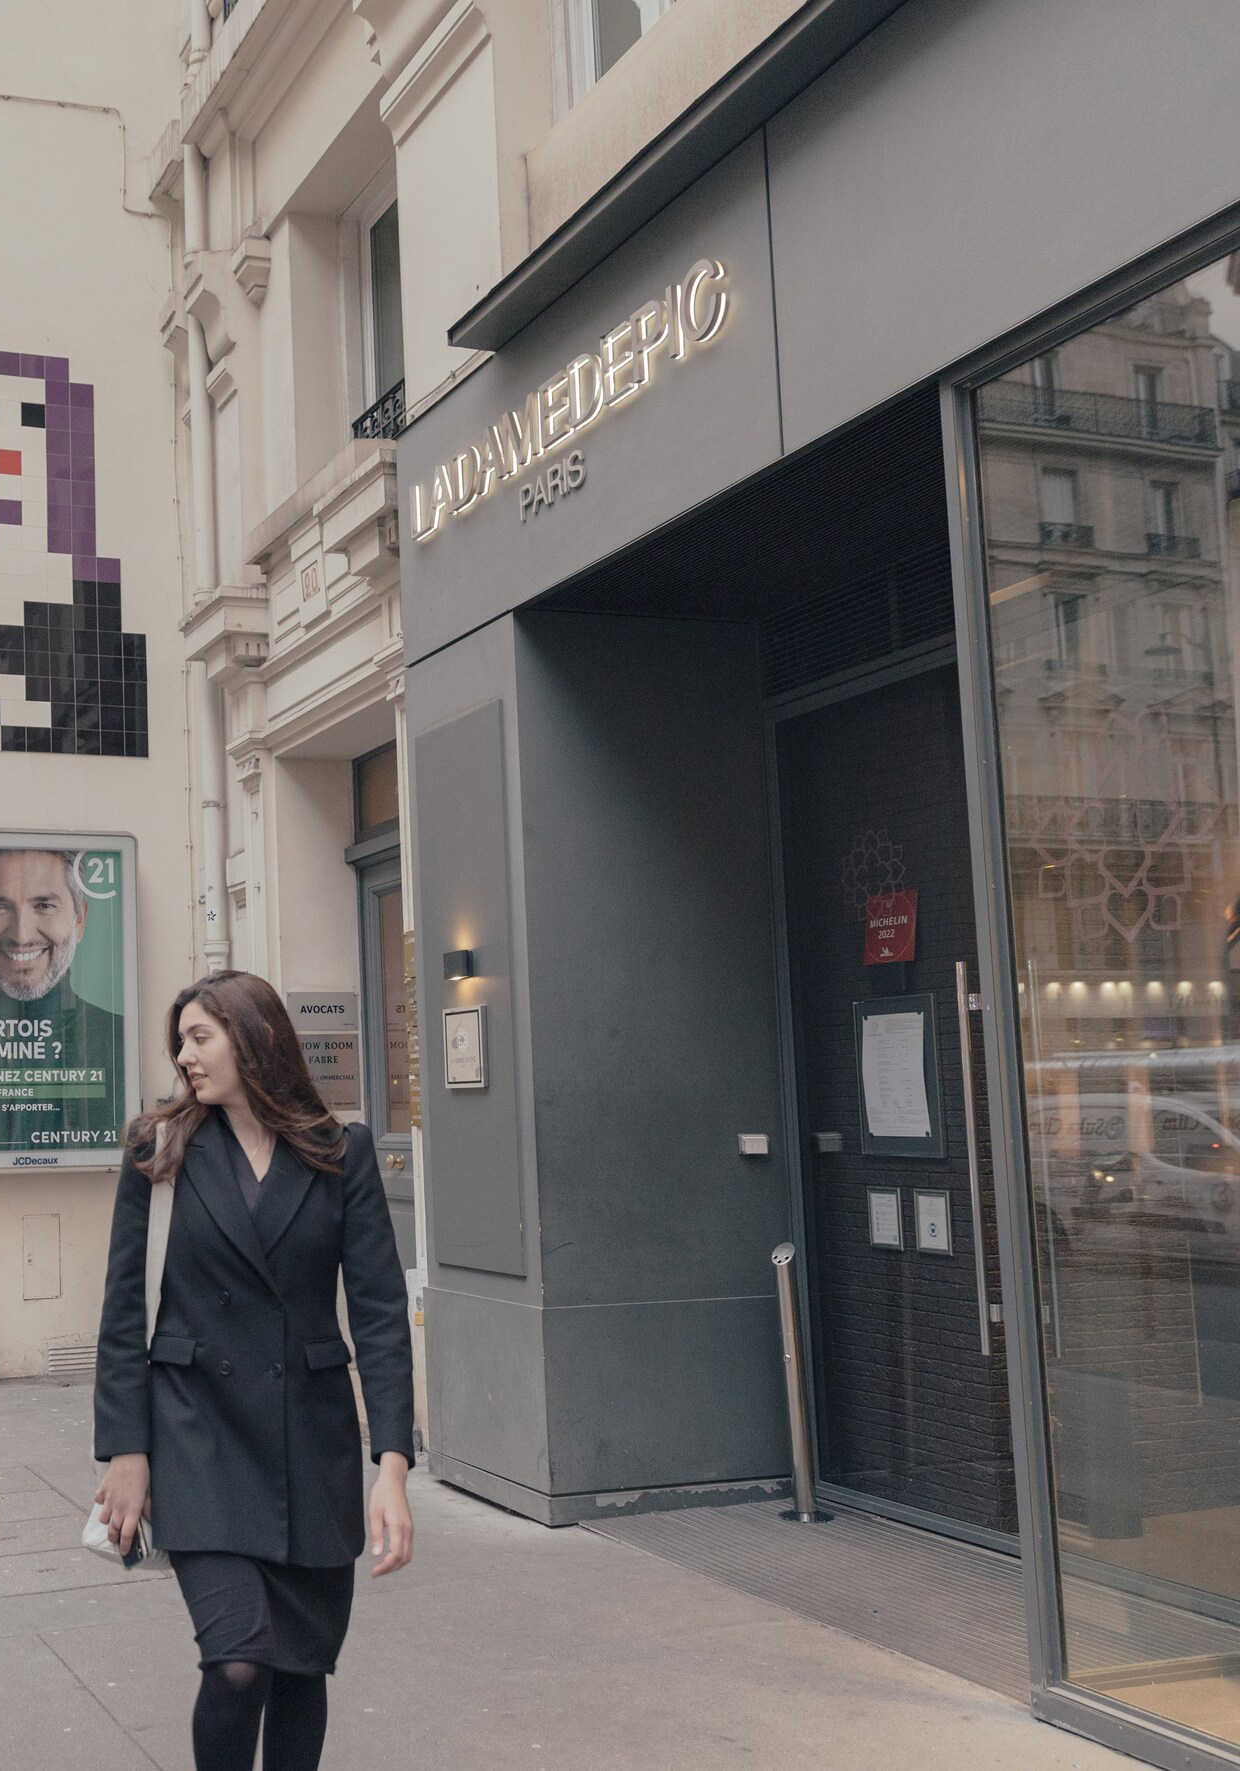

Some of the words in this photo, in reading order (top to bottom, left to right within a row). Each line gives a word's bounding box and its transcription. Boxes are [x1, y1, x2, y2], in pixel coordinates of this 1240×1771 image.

[411, 258, 727, 541] LADAMEDEPIC
[519, 450, 586, 522] PARIS
[869, 915, 908, 929] MICHELIN
[878, 928, 895, 939] 2022
[300, 1005, 345, 1014] AVOCATS
[51, 1041, 62, 1059] ?
[324, 1041, 353, 1050] ROOM
[308, 1055, 339, 1064] FABRE
[24, 1070, 86, 1082] CENTURY
[90, 1070, 103, 1081] 21
[30, 1130, 101, 1143] CENTURY
[103, 1130, 116, 1142] 21
[12, 1156, 59, 1166] JCDecaux
